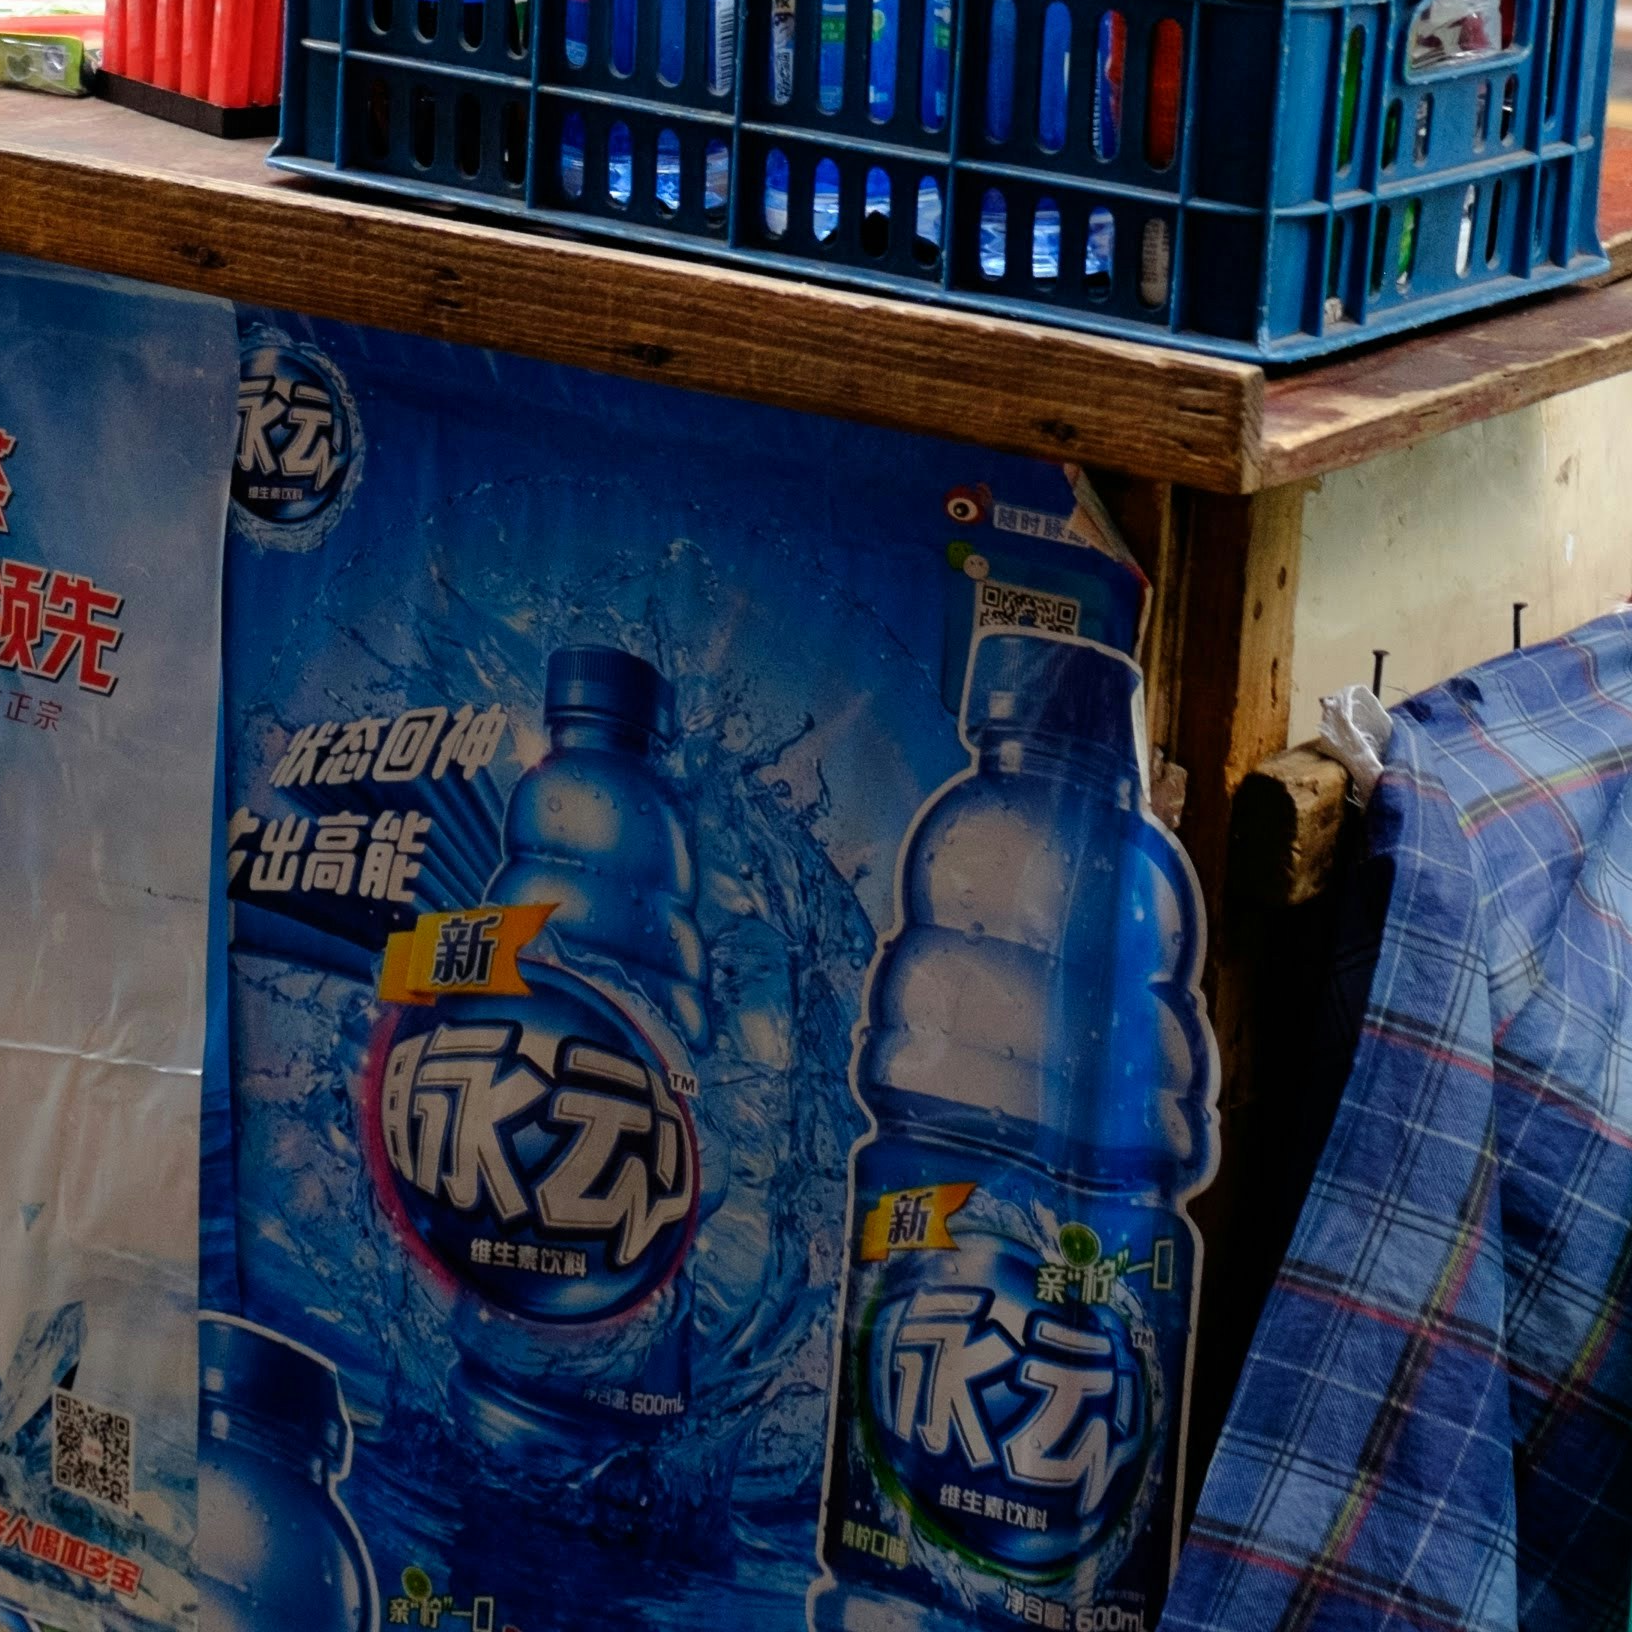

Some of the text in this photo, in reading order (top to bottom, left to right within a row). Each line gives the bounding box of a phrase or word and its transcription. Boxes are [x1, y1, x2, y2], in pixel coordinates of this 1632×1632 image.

[272, 704, 509, 788] 状态回神
[430, 913, 500, 986] 新
[382, 1024, 694, 1265] 脉动
[888, 1193, 934, 1245] 新
[469, 1238, 587, 1278] 维生素饮料
[938, 1482, 1049, 1533] 维生素饮料
